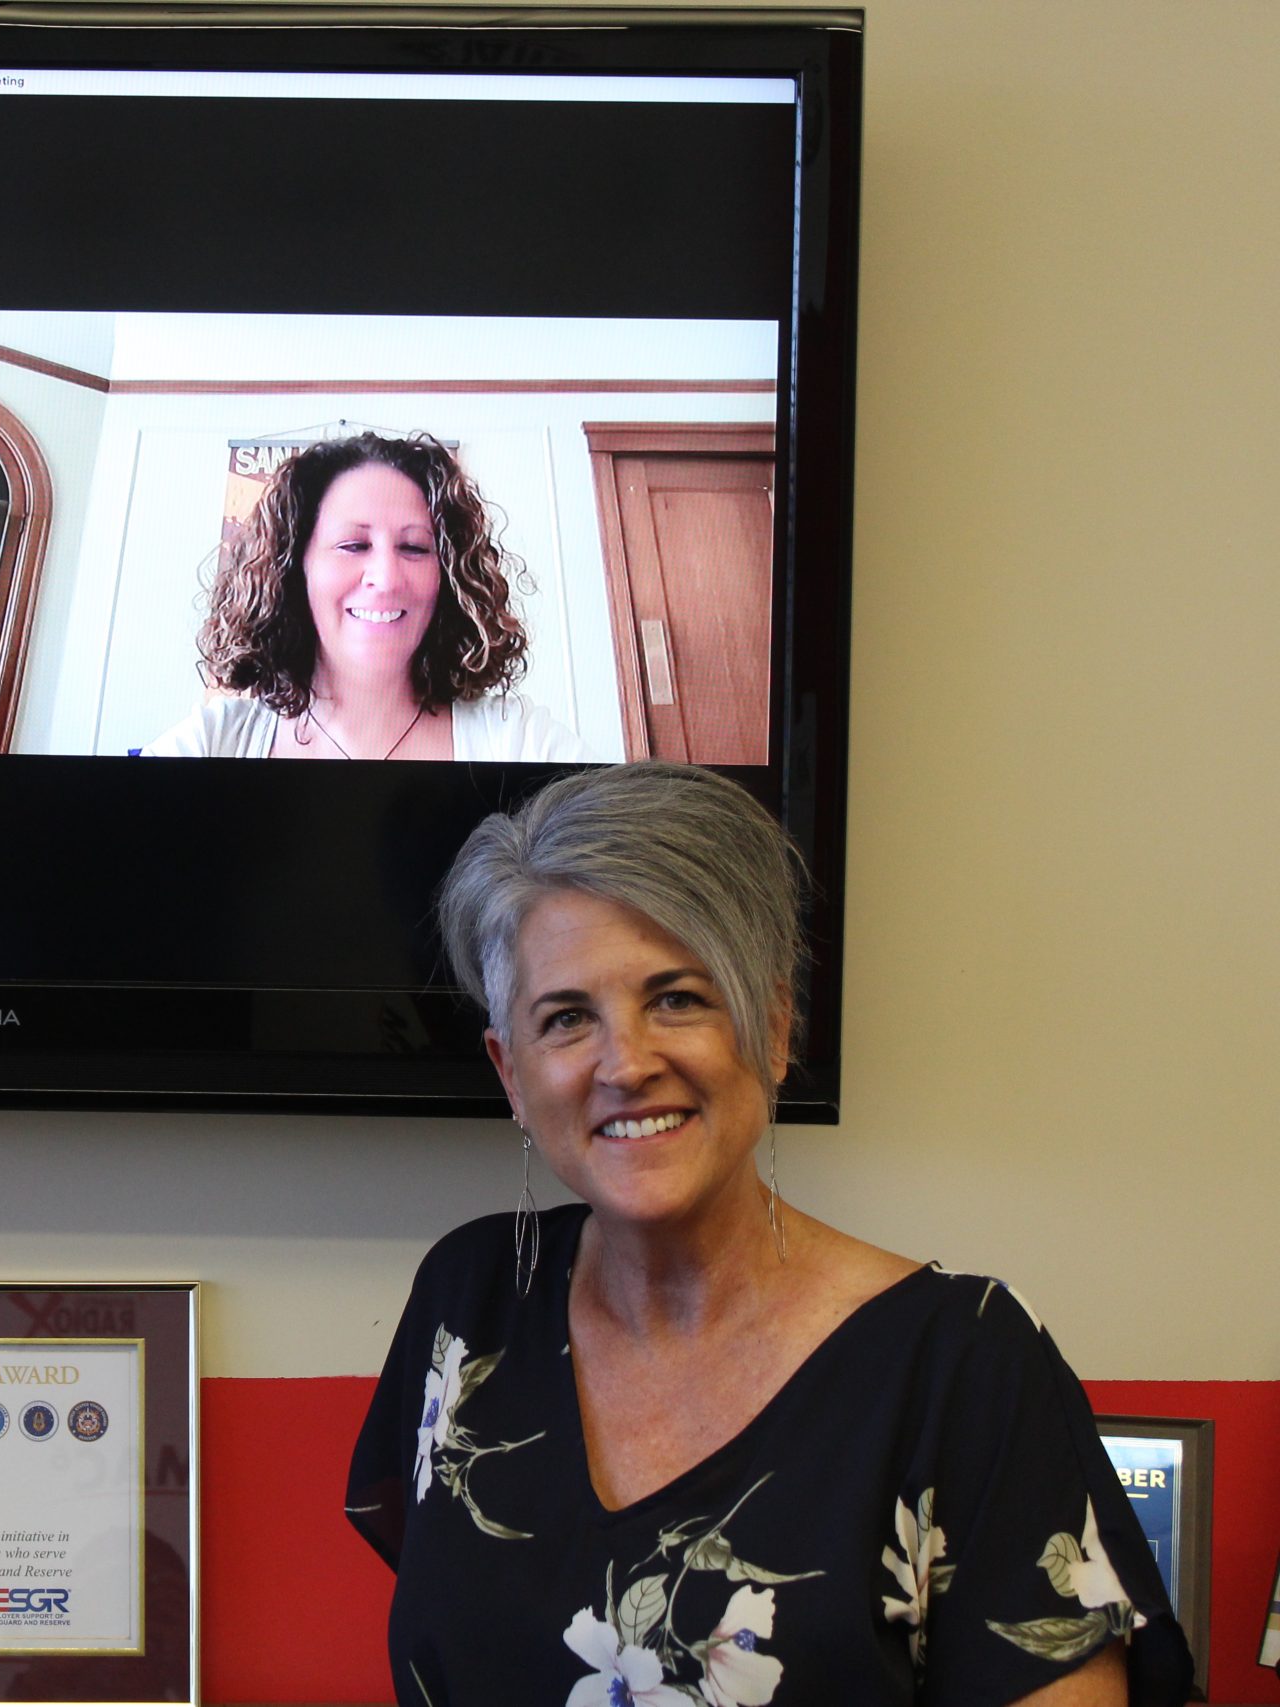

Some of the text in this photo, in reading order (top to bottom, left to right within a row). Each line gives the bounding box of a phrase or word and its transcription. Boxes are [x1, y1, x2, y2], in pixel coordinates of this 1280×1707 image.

[1, 1530, 55, 1542] initiative
[58, 1531, 69, 1542] in
[5, 1547, 30, 1559] who
[33, 1550, 66, 1559] serve
[24, 1565, 72, 1577] Reserve
